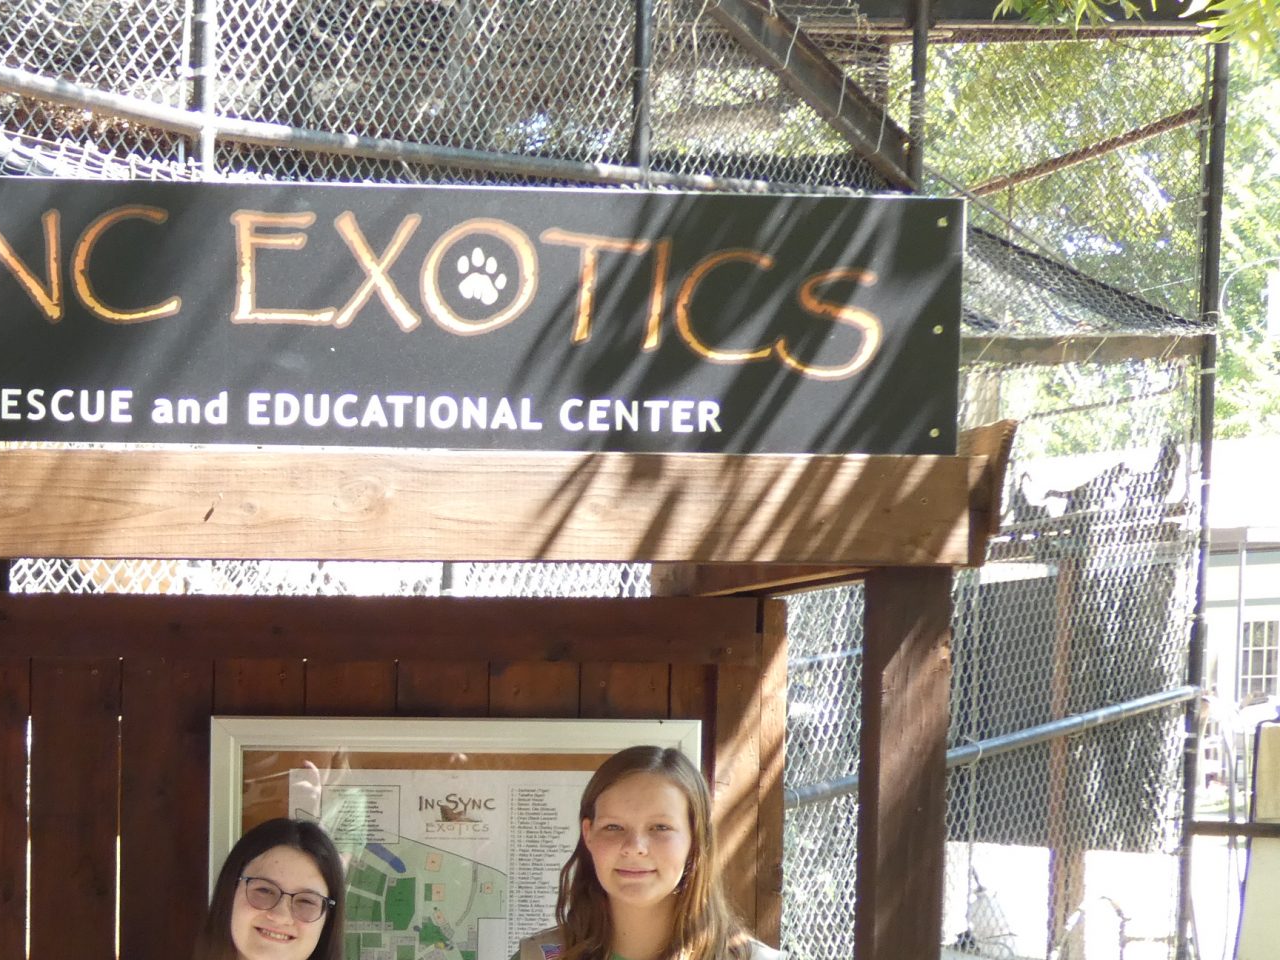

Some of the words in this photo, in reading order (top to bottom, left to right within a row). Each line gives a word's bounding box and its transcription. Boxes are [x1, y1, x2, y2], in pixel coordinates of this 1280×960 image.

[230, 210, 885, 381] EXOTICS
[151, 391, 229, 425] and
[247, 392, 543, 431] EDUCATIONAL
[559, 398, 722, 433] CENTER
[426, 822, 489, 836] EXOTICS
